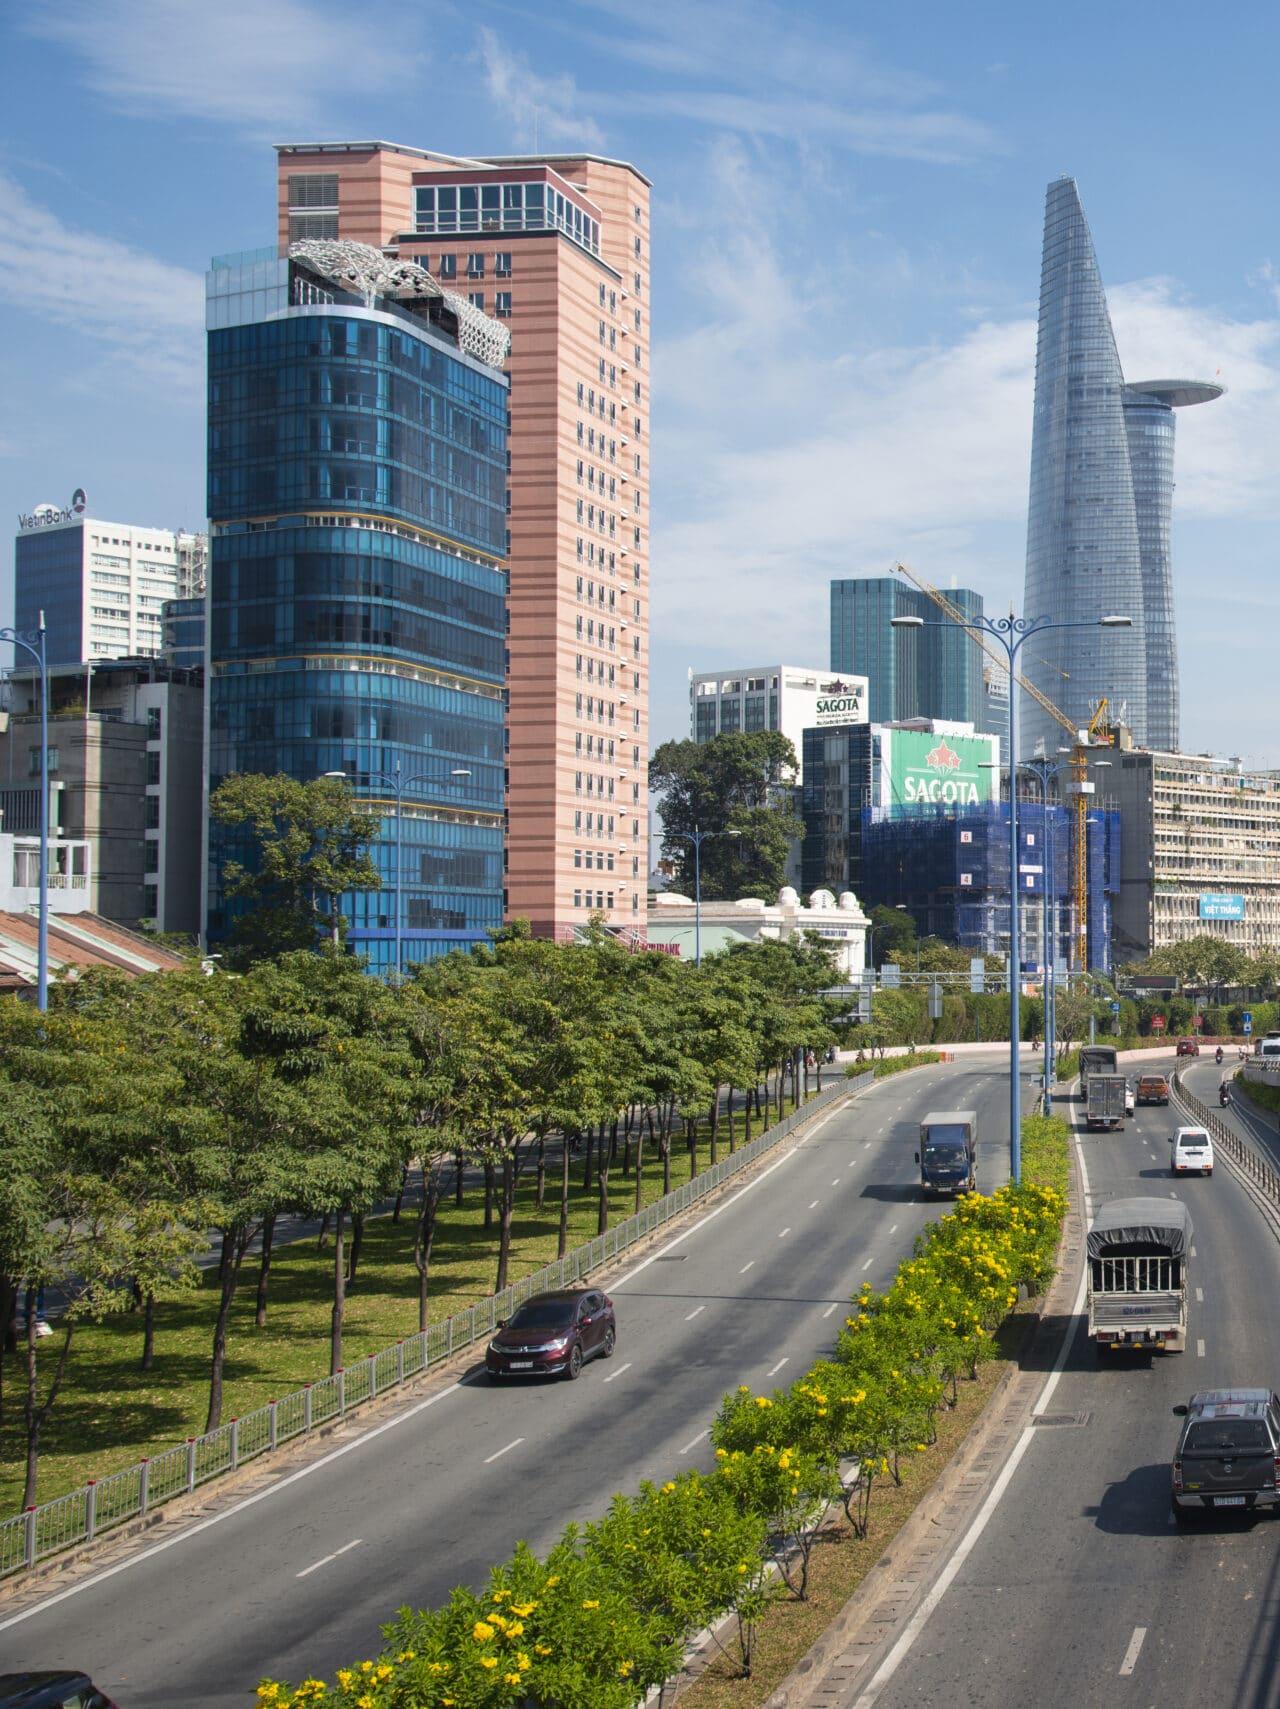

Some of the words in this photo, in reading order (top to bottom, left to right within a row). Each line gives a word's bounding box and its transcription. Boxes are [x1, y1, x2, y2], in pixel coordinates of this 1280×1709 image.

[18, 505, 73, 529] VietinBank
[816, 698, 859, 714] SAGOTA
[904, 776, 980, 806] SAGOTA
